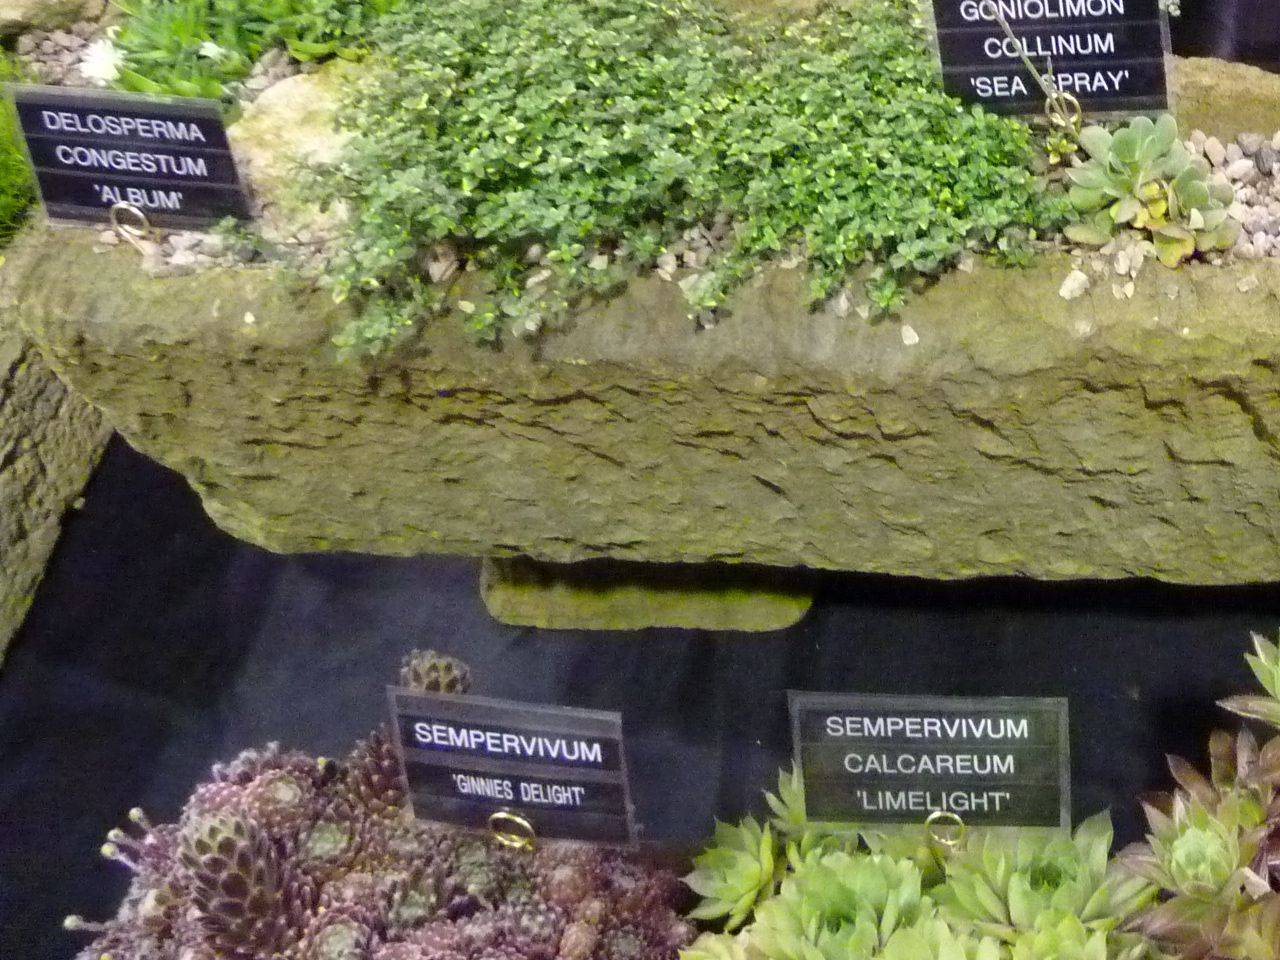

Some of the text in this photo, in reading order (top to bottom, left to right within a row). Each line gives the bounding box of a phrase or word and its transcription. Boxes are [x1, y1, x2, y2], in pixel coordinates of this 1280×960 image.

[984, 32, 1114, 58] COLLINUM
[970, 75, 1028, 97] 'SEA
[42, 110, 206, 142] DELOSPERMA
[55, 145, 208, 177] CONGESTUM
[94, 184, 183, 210] 'ALBUM'
[826, 716, 1028, 738] SEMPERVIVUM
[414, 722, 602, 763] SEMPERVIVUM
[844, 753, 1014, 774] CALCAREUM
[453, 773, 585, 805] 'GINNIES DELIGHT'
[856, 791, 1010, 811] 'LIMELIGHT'
